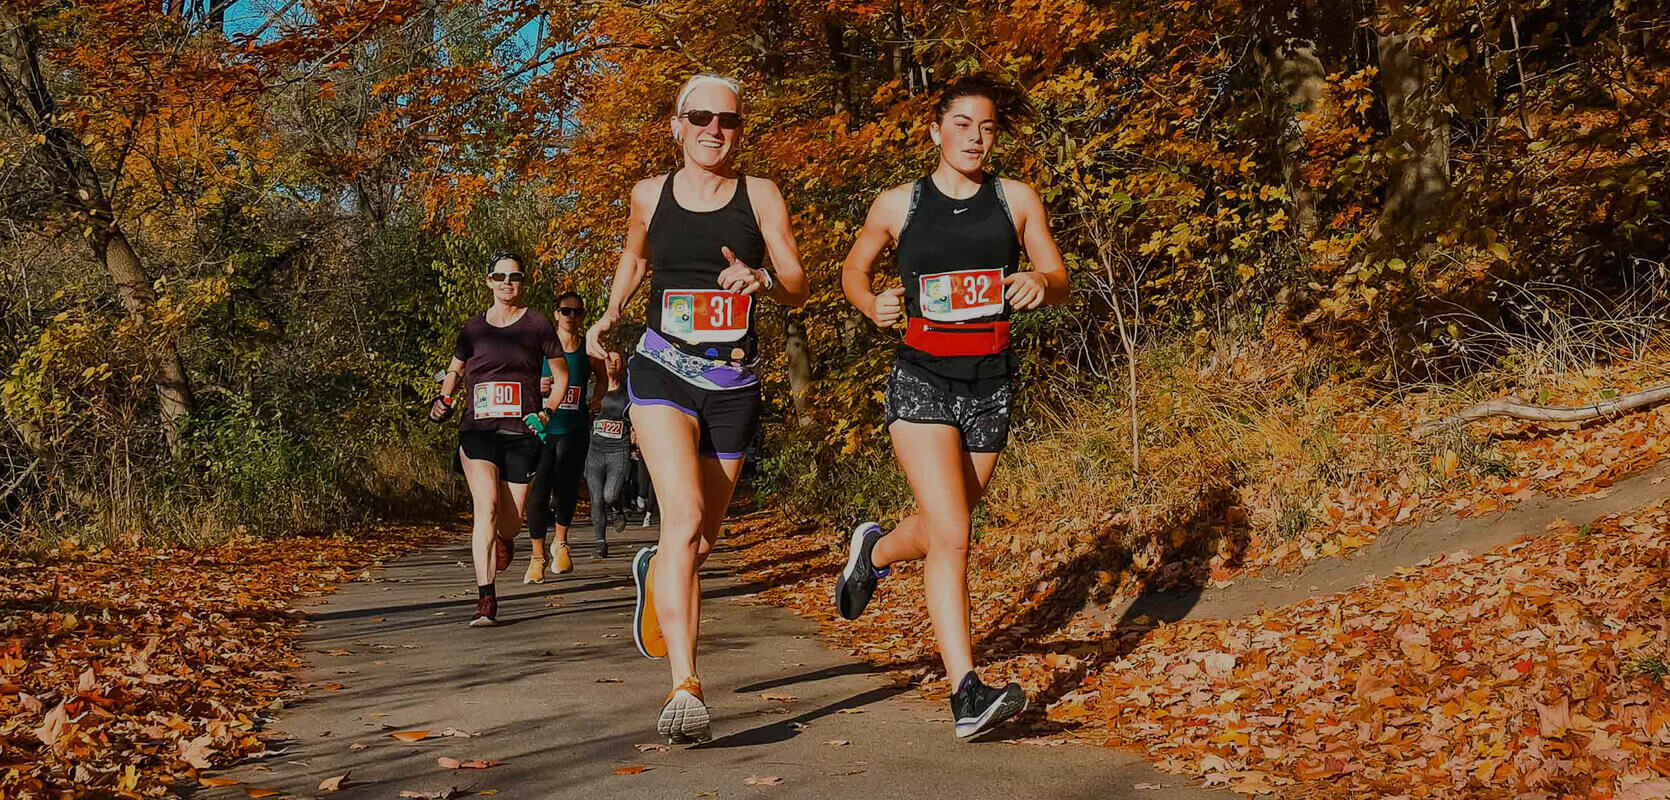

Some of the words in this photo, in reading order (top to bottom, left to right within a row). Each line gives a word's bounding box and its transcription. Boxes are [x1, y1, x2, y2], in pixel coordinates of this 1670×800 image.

[963, 275, 990, 304] 32
[710, 296, 733, 327] 31
[495, 385, 513, 404] 90
[605, 422, 621, 434] 222
